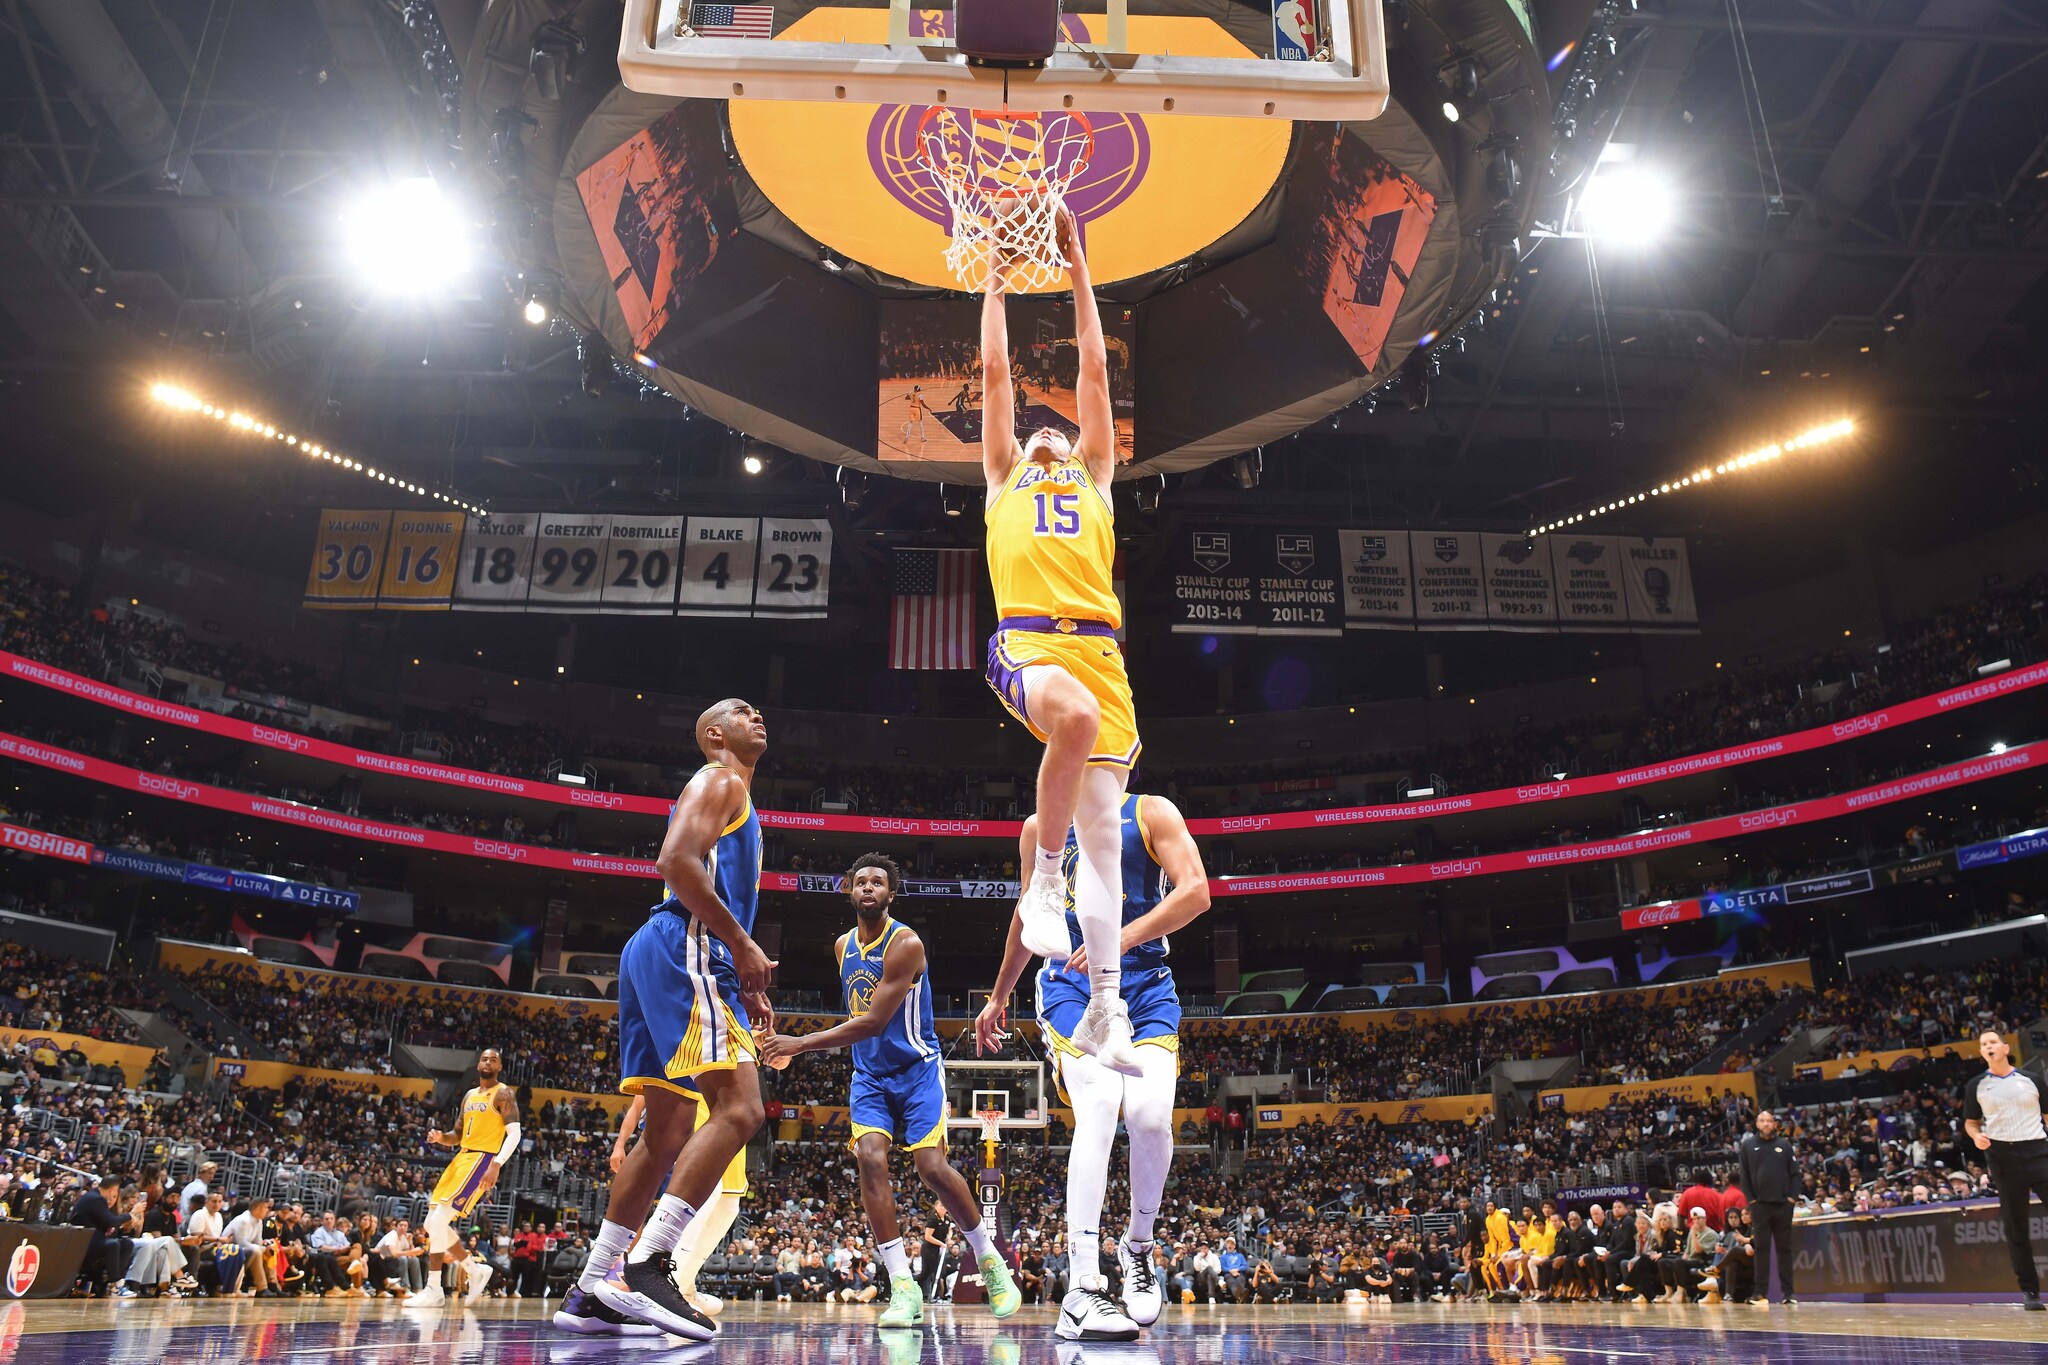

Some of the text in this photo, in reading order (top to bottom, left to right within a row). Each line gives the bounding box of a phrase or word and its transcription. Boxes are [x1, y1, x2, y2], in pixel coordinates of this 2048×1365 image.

[1281, 47, 1302, 60] NBA
[1033, 492, 1081, 538] 15
[328, 519, 380, 532] VACHON
[401, 522, 453, 534] DIONNE
[478, 523, 525, 536] TAYLOR
[544, 524, 604, 537] GRETZKY
[612, 525, 679, 539] ROBITAILLE
[700, 528, 743, 541] BLAKE
[772, 530, 822, 543] BROWN
[1631, 547, 1678, 560] MILLER
[318, 544, 374, 582] 30
[397, 546, 440, 584] 16
[472, 546, 517, 584] 18
[542, 547, 597, 587] 99
[612, 549, 670, 589] 20
[703, 551, 730, 590] 4
[766, 553, 820, 593] 23
[1425, 567, 1471, 576] WESTERN
[1494, 568, 1542, 578] CAMPBELL
[1570, 569, 1606, 579] SMYTHE
[1175, 575, 1250, 588] STANLEY CUP
[1259, 578, 1335, 590] STANLEY CUP
[1347, 575, 1407, 587] CONFERENCE
[1419, 577, 1479, 588] CONFERENCE
[1490, 578, 1549, 589] CONFERENCE
[1569, 580, 1610, 589] DIVISION
[1176, 587, 1251, 601] CHAMPIONS
[1260, 591, 1336, 603] CHAMPIONS
[1351, 586, 1405, 598] CHAMPIONS
[1422, 588, 1478, 598] CHAMPIONS
[1494, 589, 1548, 600] CHAMPIONS
[1564, 590, 1618, 600] CHAMPIONS
[1186, 604, 1242, 620] 2013-14
[1359, 600, 1399, 612] 2013-14
[1432, 601, 1472, 613] 2011-12
[1500, 602, 1544, 615] 1992-93
[1571, 603, 1614, 615] 1990-91
[1272, 607, 1325, 622] 2011-12
[12, 660, 200, 724] WIRELESS COVERAGE SOLUTIONS
[1937, 666, 2048, 707] WIRELESS COVERA
[1832, 712, 1889, 737] boldyn
[252, 724, 308, 751] boldyn
[18, 743, 86, 771] SOLUTIONS
[1616, 741, 1783, 785] WIRELESS COVERAGE SOLUTIONS
[356, 754, 524, 792] WIRELESS COVERAGE SOLUTIONS
[1846, 752, 2029, 808] WIRELESS COVERAGE SOLUTIONS
[137, 772, 200, 800] boldyn
[1516, 781, 1570, 799] boldyn
[569, 788, 623, 808] boldyn
[1315, 798, 1472, 822] WIRELESS COVERAGE SOLUTIONS
[251, 800, 425, 843] WIRELESS COVERAGE SOLUTIONS
[771, 814, 825, 826] SOLUTIONS
[869, 818, 920, 833] boldyn
[1220, 816, 1271, 831] boldyn
[1738, 807, 1797, 829] boldyn
[929, 820, 979, 835] boldyn
[3, 826, 88, 861] TOSHIBA
[473, 839, 527, 860] boldyn
[1527, 830, 1692, 863] WIRELESS COVERAGE SOLUTIONS
[2008, 837, 2048, 854] ULTRA
[572, 857, 660, 875] WIRELESS COVER
[1430, 859, 1481, 876] boldyn
[234, 877, 271, 893] ULTRA
[806, 881, 813, 890] 5
[822, 882, 828, 890] 4
[919, 885, 951, 894] Lakers
[968, 882, 1007, 897] 7:29
[1228, 872, 1385, 892] WIRELESS COVERAGE SOLUTIONS
[1801, 878, 1851, 893] 3 Point Titans
[299, 887, 353, 909] DELTA
[1724, 891, 1779, 910] DELTA
[1638, 904, 1681, 925] Coca-Cola
[203, 958, 522, 1008] LOS ANGELES LAKERS
[845, 968, 864, 986] GOLDEN
[862, 987, 875, 1002] 22
[1466, 974, 1768, 1021] LOS ANGELES LAKERS
[1231, 1015, 1343, 1032] LAKERS
[223, 1064, 242, 1075] 114
[1626, 1085, 1693, 1097] LOS ANGELES
[783, 1108, 795, 1119] 15
[1262, 1111, 1279, 1121] 116
[466, 1117, 474, 1138] 1
[1564, 1185, 1629, 1199] 17x CHAMPIONS
[982, 1205, 997, 1217] GET
[1954, 1218, 2007, 1245] SEAS
[218, 1243, 239, 1261] 30
[1839, 1224, 1946, 1284] TIP-OFF 2023
